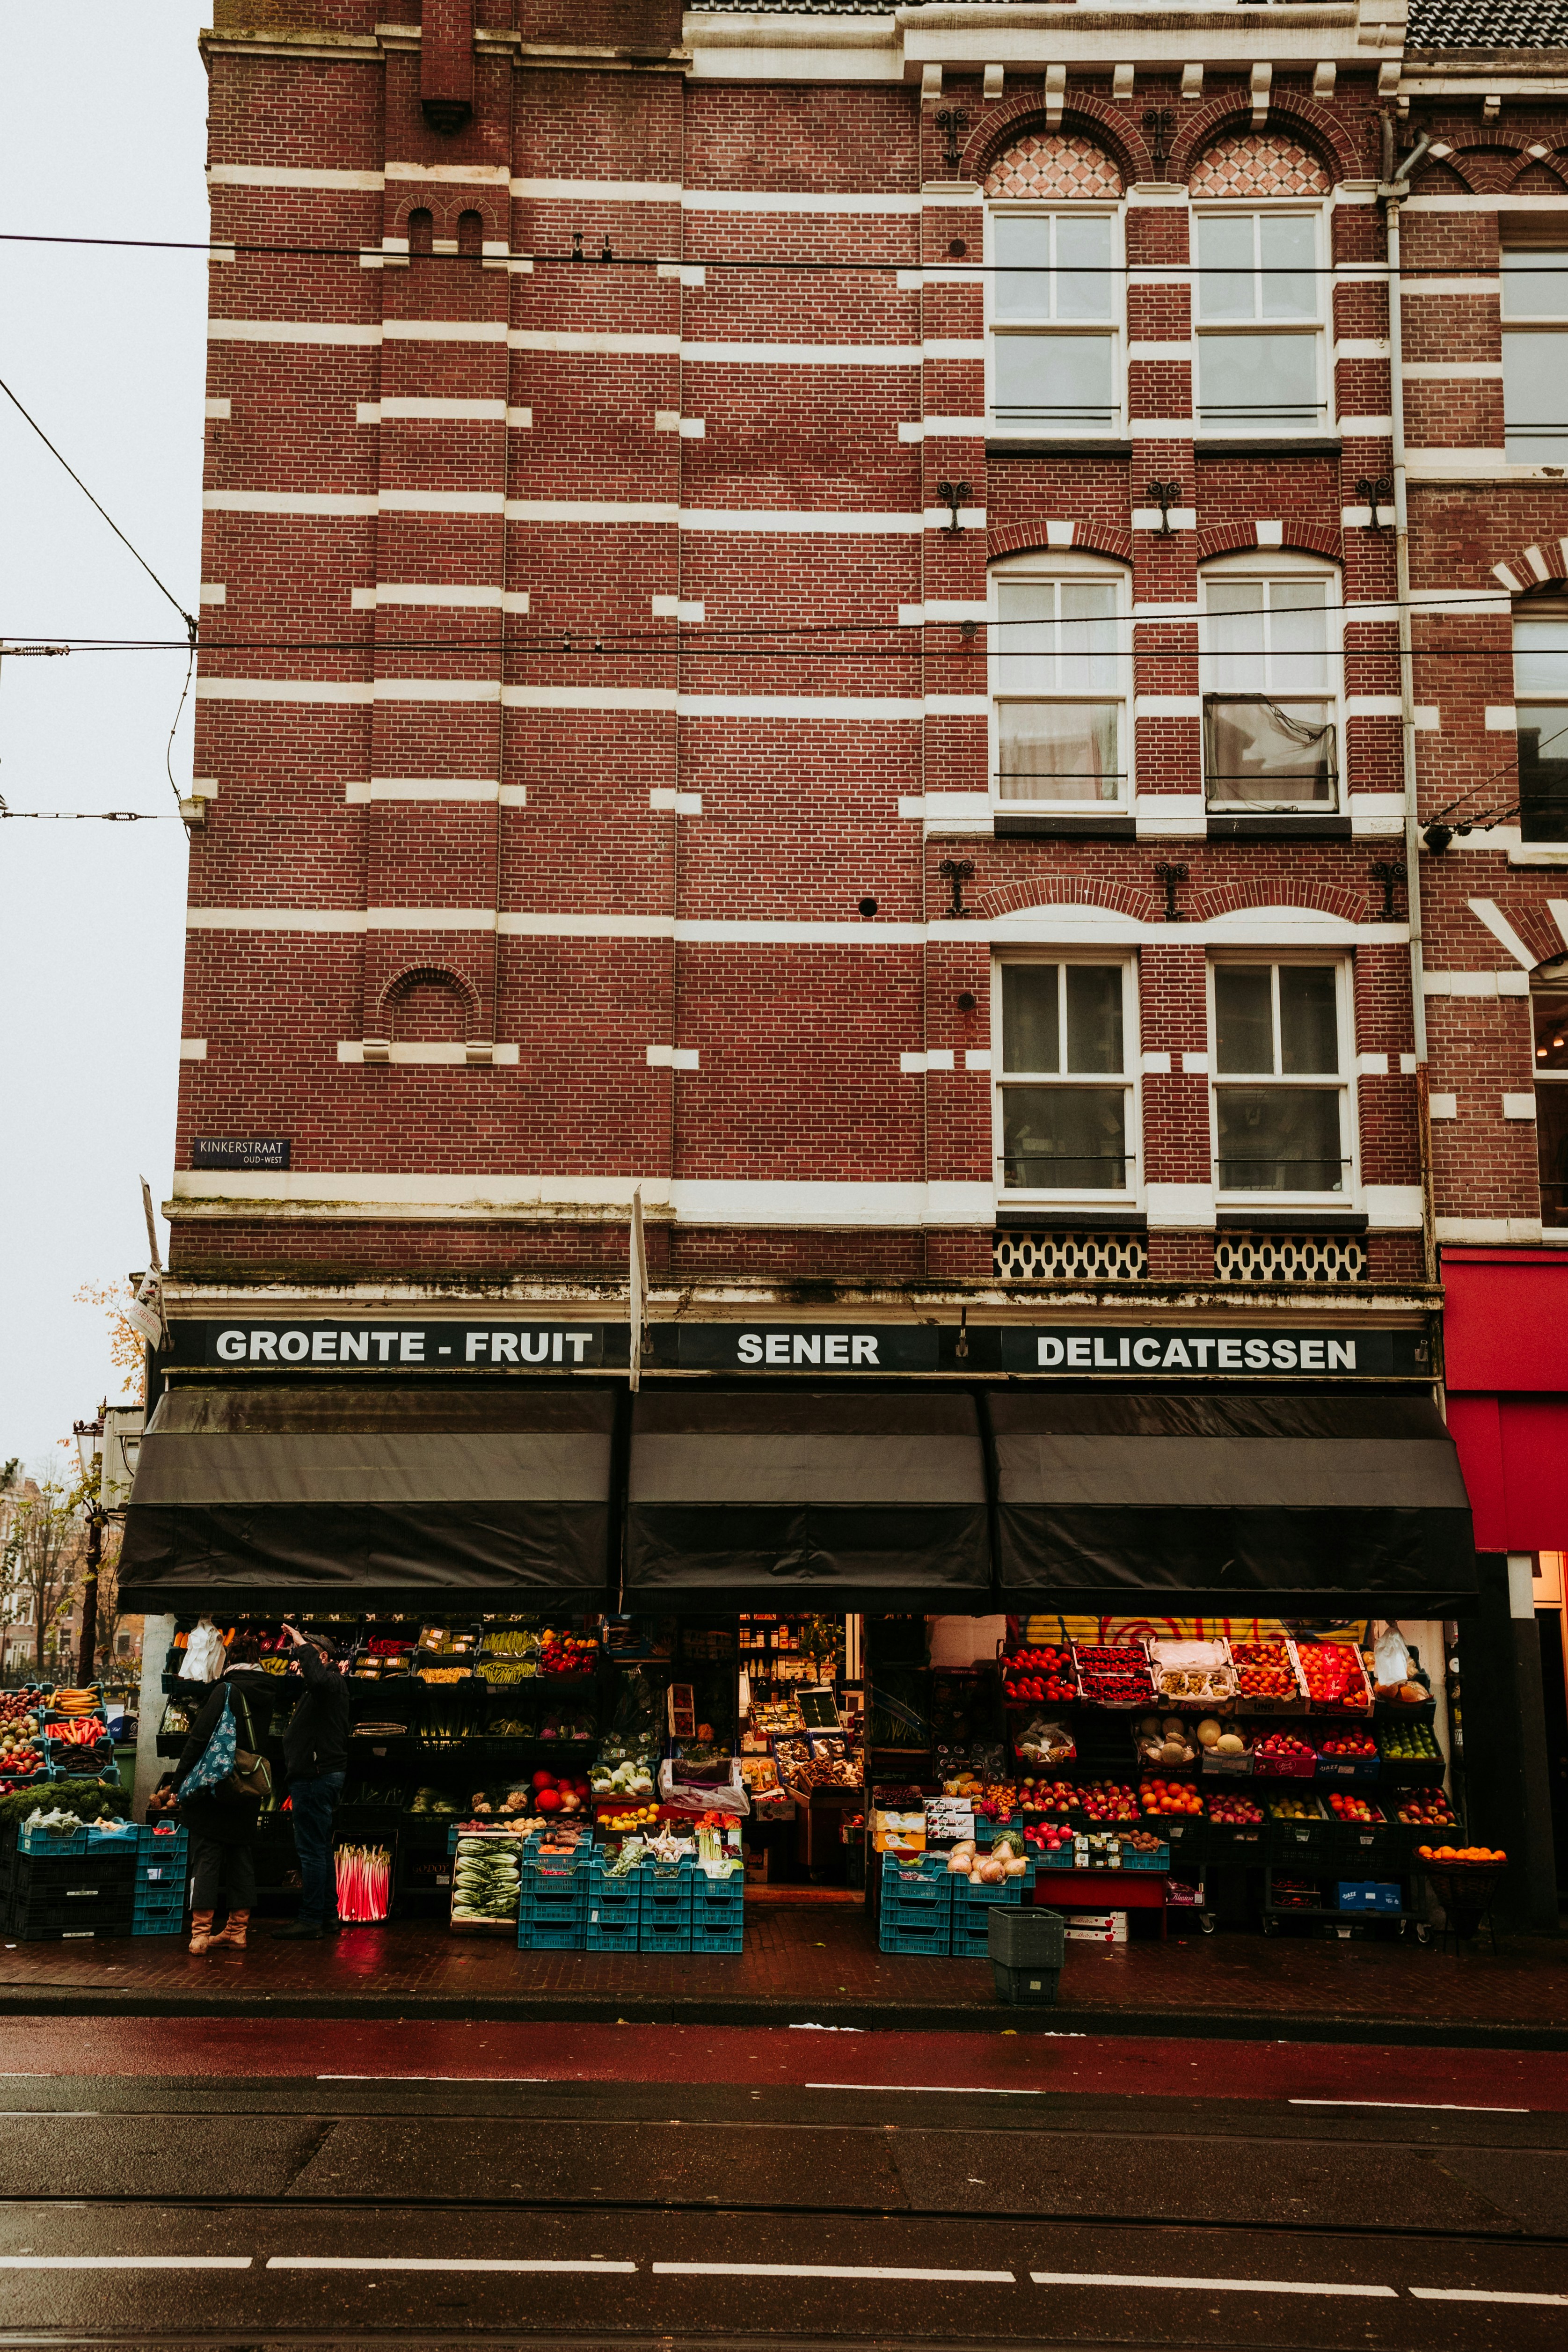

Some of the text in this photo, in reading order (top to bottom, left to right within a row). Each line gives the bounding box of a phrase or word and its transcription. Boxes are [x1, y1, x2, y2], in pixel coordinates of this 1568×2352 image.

[200, 1141, 283, 1154] KINKERSTRAAT
[216, 1330, 425, 1361] GROENTE
[466, 1332, 592, 1362] FRUIT
[737, 1334, 880, 1364] SENER
[1037, 1337, 1356, 1369] DELICATESSEN
[412, 1864, 449, 1873] GODOY
